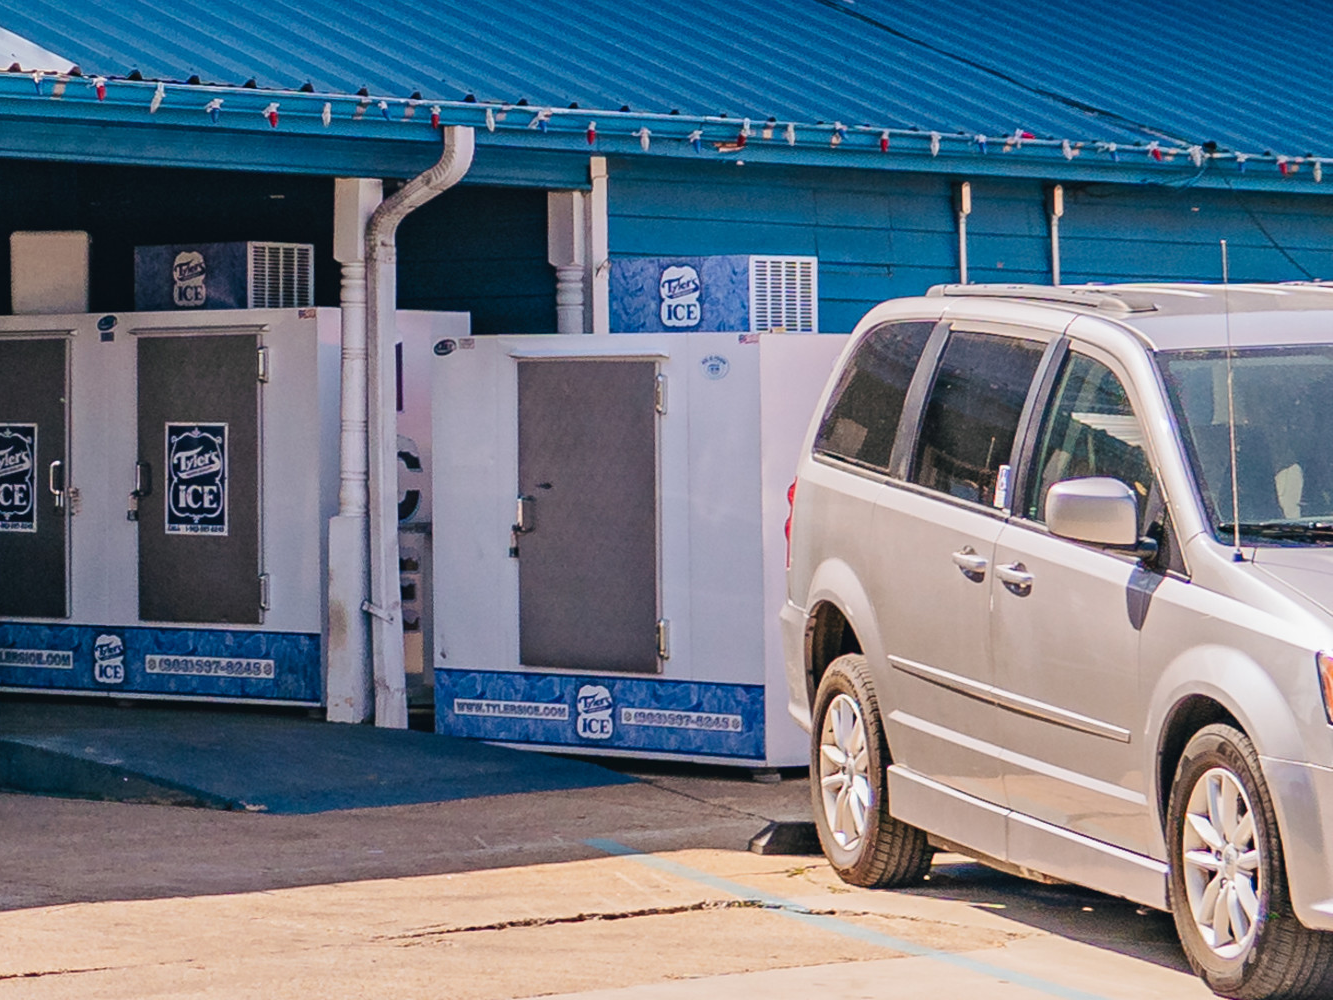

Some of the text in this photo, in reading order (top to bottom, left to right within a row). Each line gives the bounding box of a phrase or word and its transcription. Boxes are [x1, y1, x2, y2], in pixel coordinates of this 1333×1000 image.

[178, 285, 203, 301] ICE
[667, 303, 697, 321] ICE
[174, 445, 221, 473] Tyler's
[178, 485, 217, 508] ICE
[98, 664, 122, 679] ICE
[582, 718, 610, 734] ICE
